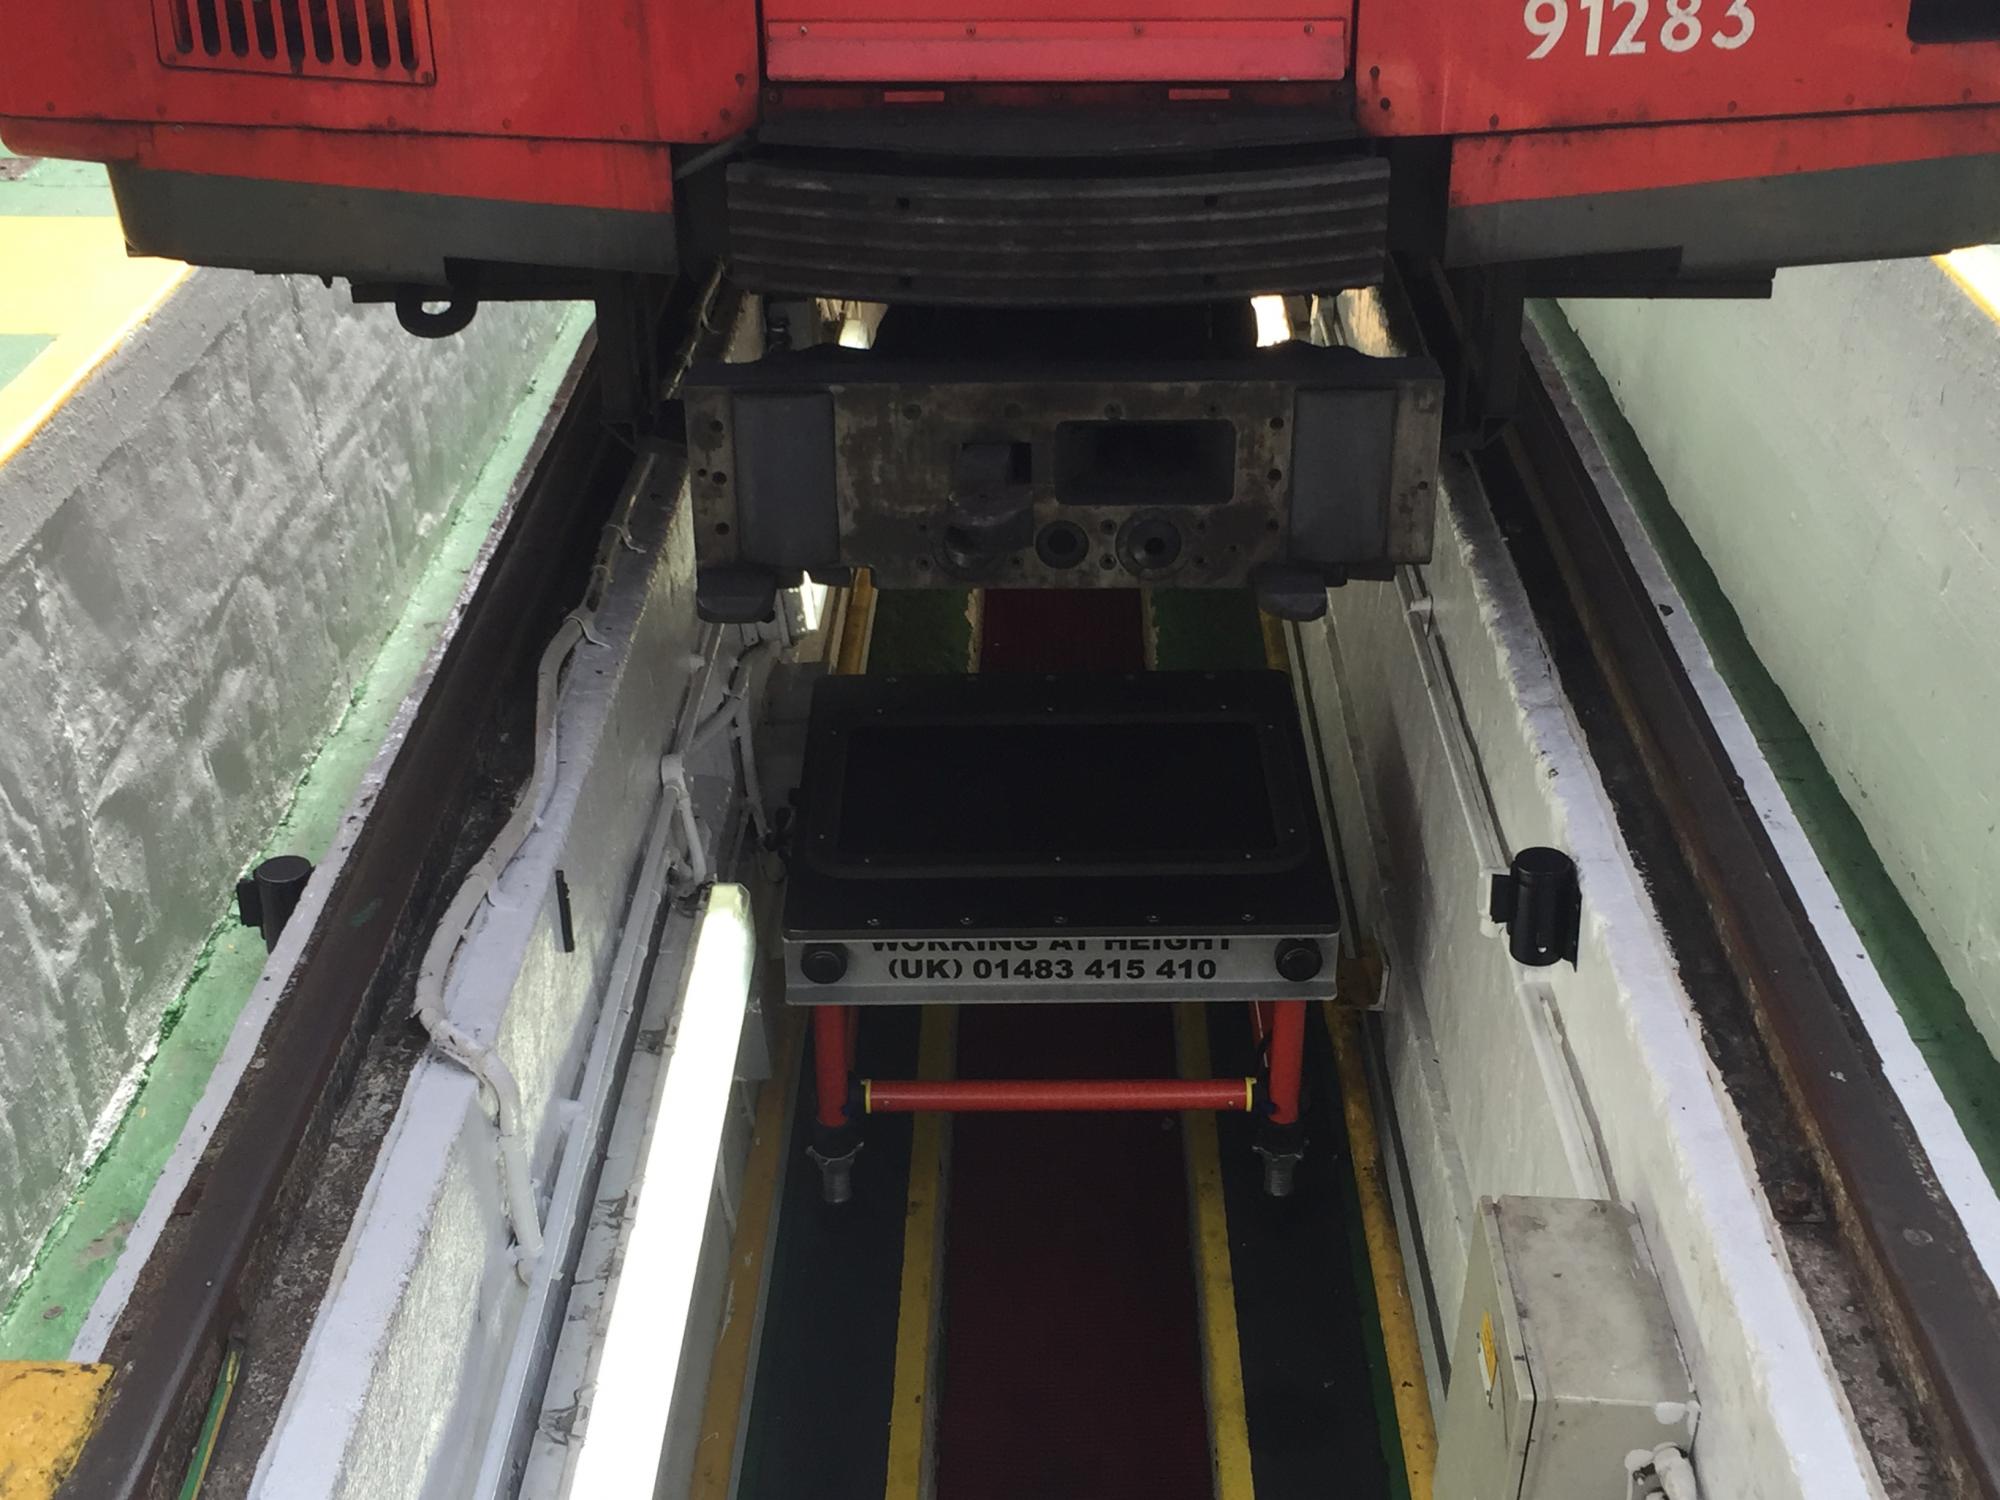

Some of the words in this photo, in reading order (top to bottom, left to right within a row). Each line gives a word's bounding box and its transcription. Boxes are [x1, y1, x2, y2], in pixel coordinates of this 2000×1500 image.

[1523, 0, 1755, 60] 91283
[888, 958, 963, 979] (UK)
[972, 958, 1074, 979] 01483
[1084, 958, 1145, 979] 415
[1155, 958, 1217, 979] 410
